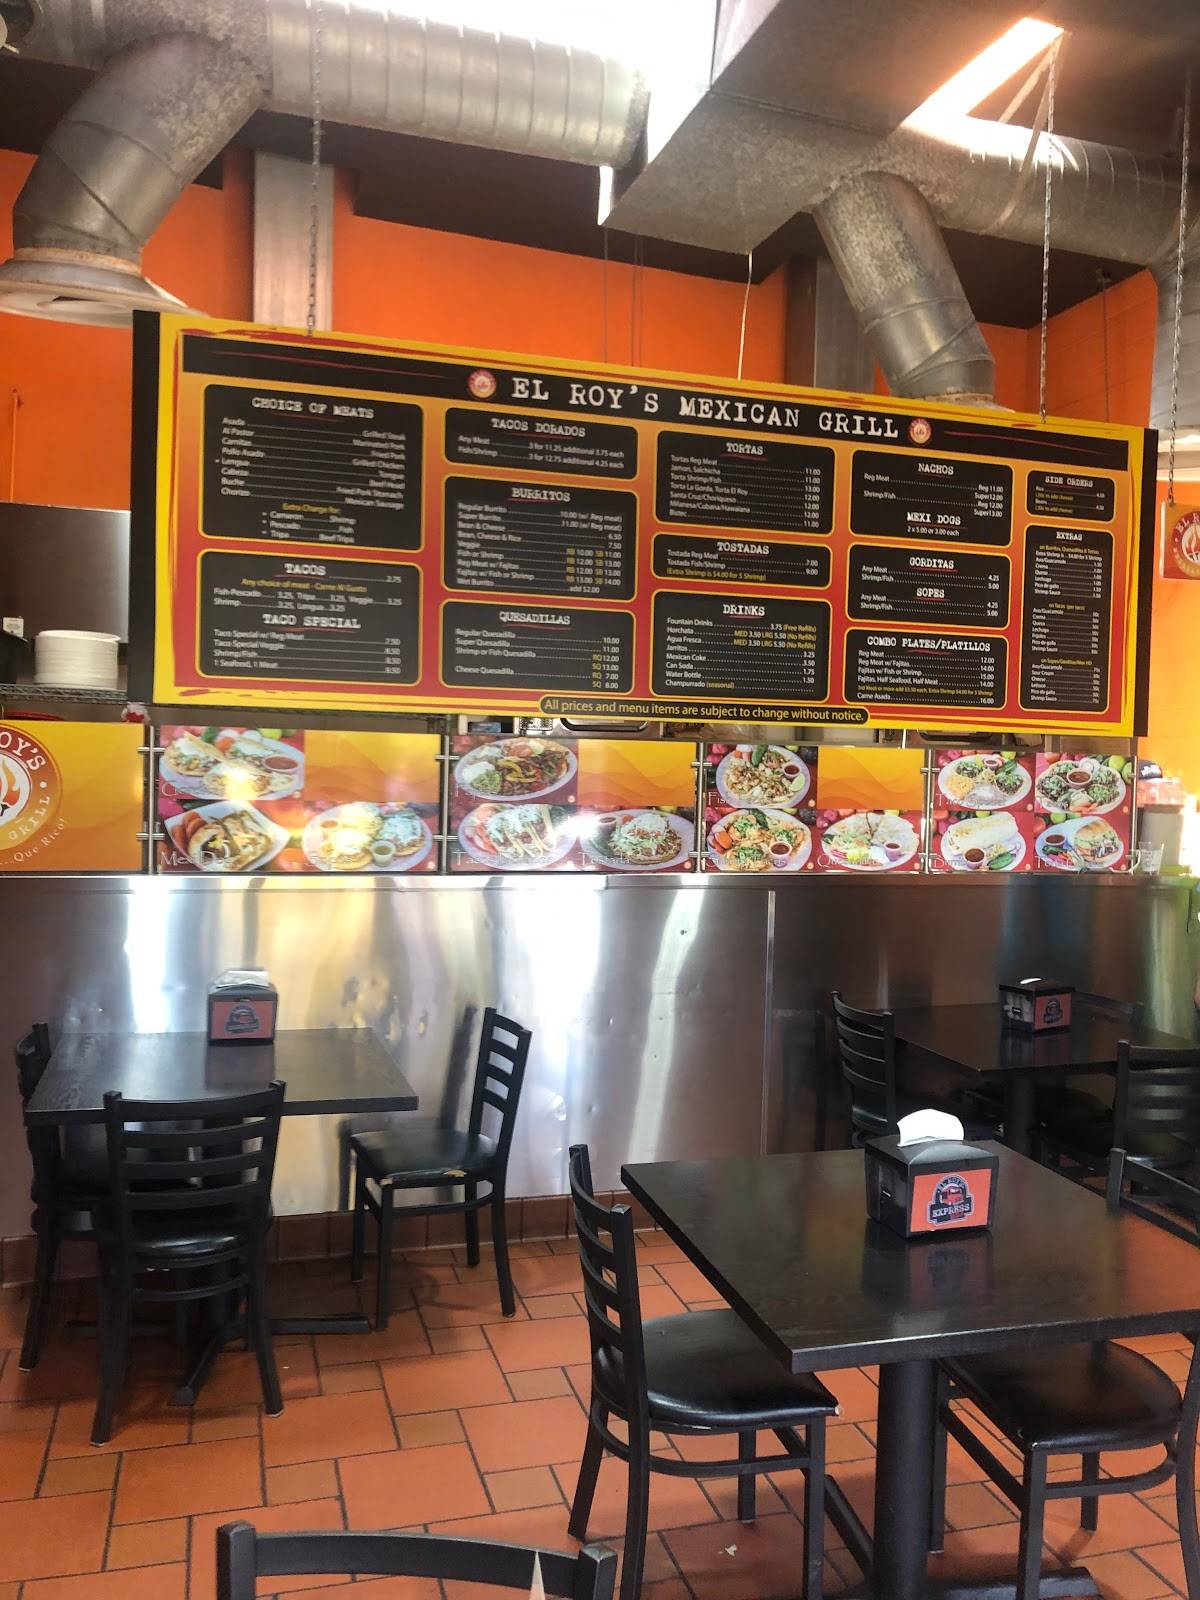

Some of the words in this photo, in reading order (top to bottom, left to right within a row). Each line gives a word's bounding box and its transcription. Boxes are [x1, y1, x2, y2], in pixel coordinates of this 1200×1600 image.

[252, 397, 303, 411] CHOICE
[309, 402, 327, 413] OF
[333, 405, 374, 419] MEATS
[511, 377, 550, 401] EL
[570, 384, 659, 414] ROY'S
[680, 396, 800, 428] MEXICAN
[818, 411, 898, 438] GRILL
[491, 418, 528, 431] TACOS
[535, 424, 586, 437] DORADOS
[726, 442, 763, 455] TORTAS
[918, 463, 954, 476] NACHOS
[512, 488, 570, 502] BURRITOS
[907, 512, 931, 523] MEXI
[937, 514, 961, 525] DOGS
[1056, 532, 1082, 541] EXTRAS
[717, 542, 769, 555] TOSTADAS
[284, 563, 326, 575] TACOS
[910, 557, 954, 569] GORDITAS
[917, 588, 945, 598] SOPES
[723, 604, 765, 616] DRINKS
[262, 614, 297, 625] TACO
[303, 616, 361, 628] SPECIAL
[499, 611, 570, 625] QUESADILLAS
[667, 617, 693, 625] Fountain
[694, 619, 712, 627] Drinks
[783, 624, 797, 632] (Free
[798, 625, 816, 633] Refills)
[667, 636, 682, 644] Agua
[761, 640, 772, 648] LRG
[786, 642, 796, 650] (No
[787, 633, 796, 641] (No
[867, 636, 896, 647] COMBO
[902, 638, 991, 652] PLATES/PLATILLOS
[666, 653, 690, 661] Mexican
[859, 650, 870, 658] Reg
[706, 681, 735, 689] (seasonal)
[544, 699, 559, 712] All
[561, 701, 593, 714] prices
[595, 701, 616, 713] and
[618, 704, 649, 715] menu
[652, 704, 680, 716] items
[682, 707, 698, 717] are
[700, 705, 738, 720] subject
[739, 708, 750, 718] to
[752, 709, 789, 722] change
[791, 709, 830, 720] without
[832, 711, 864, 722] notice.
[932, 1204, 970, 1217] EXPRESS
